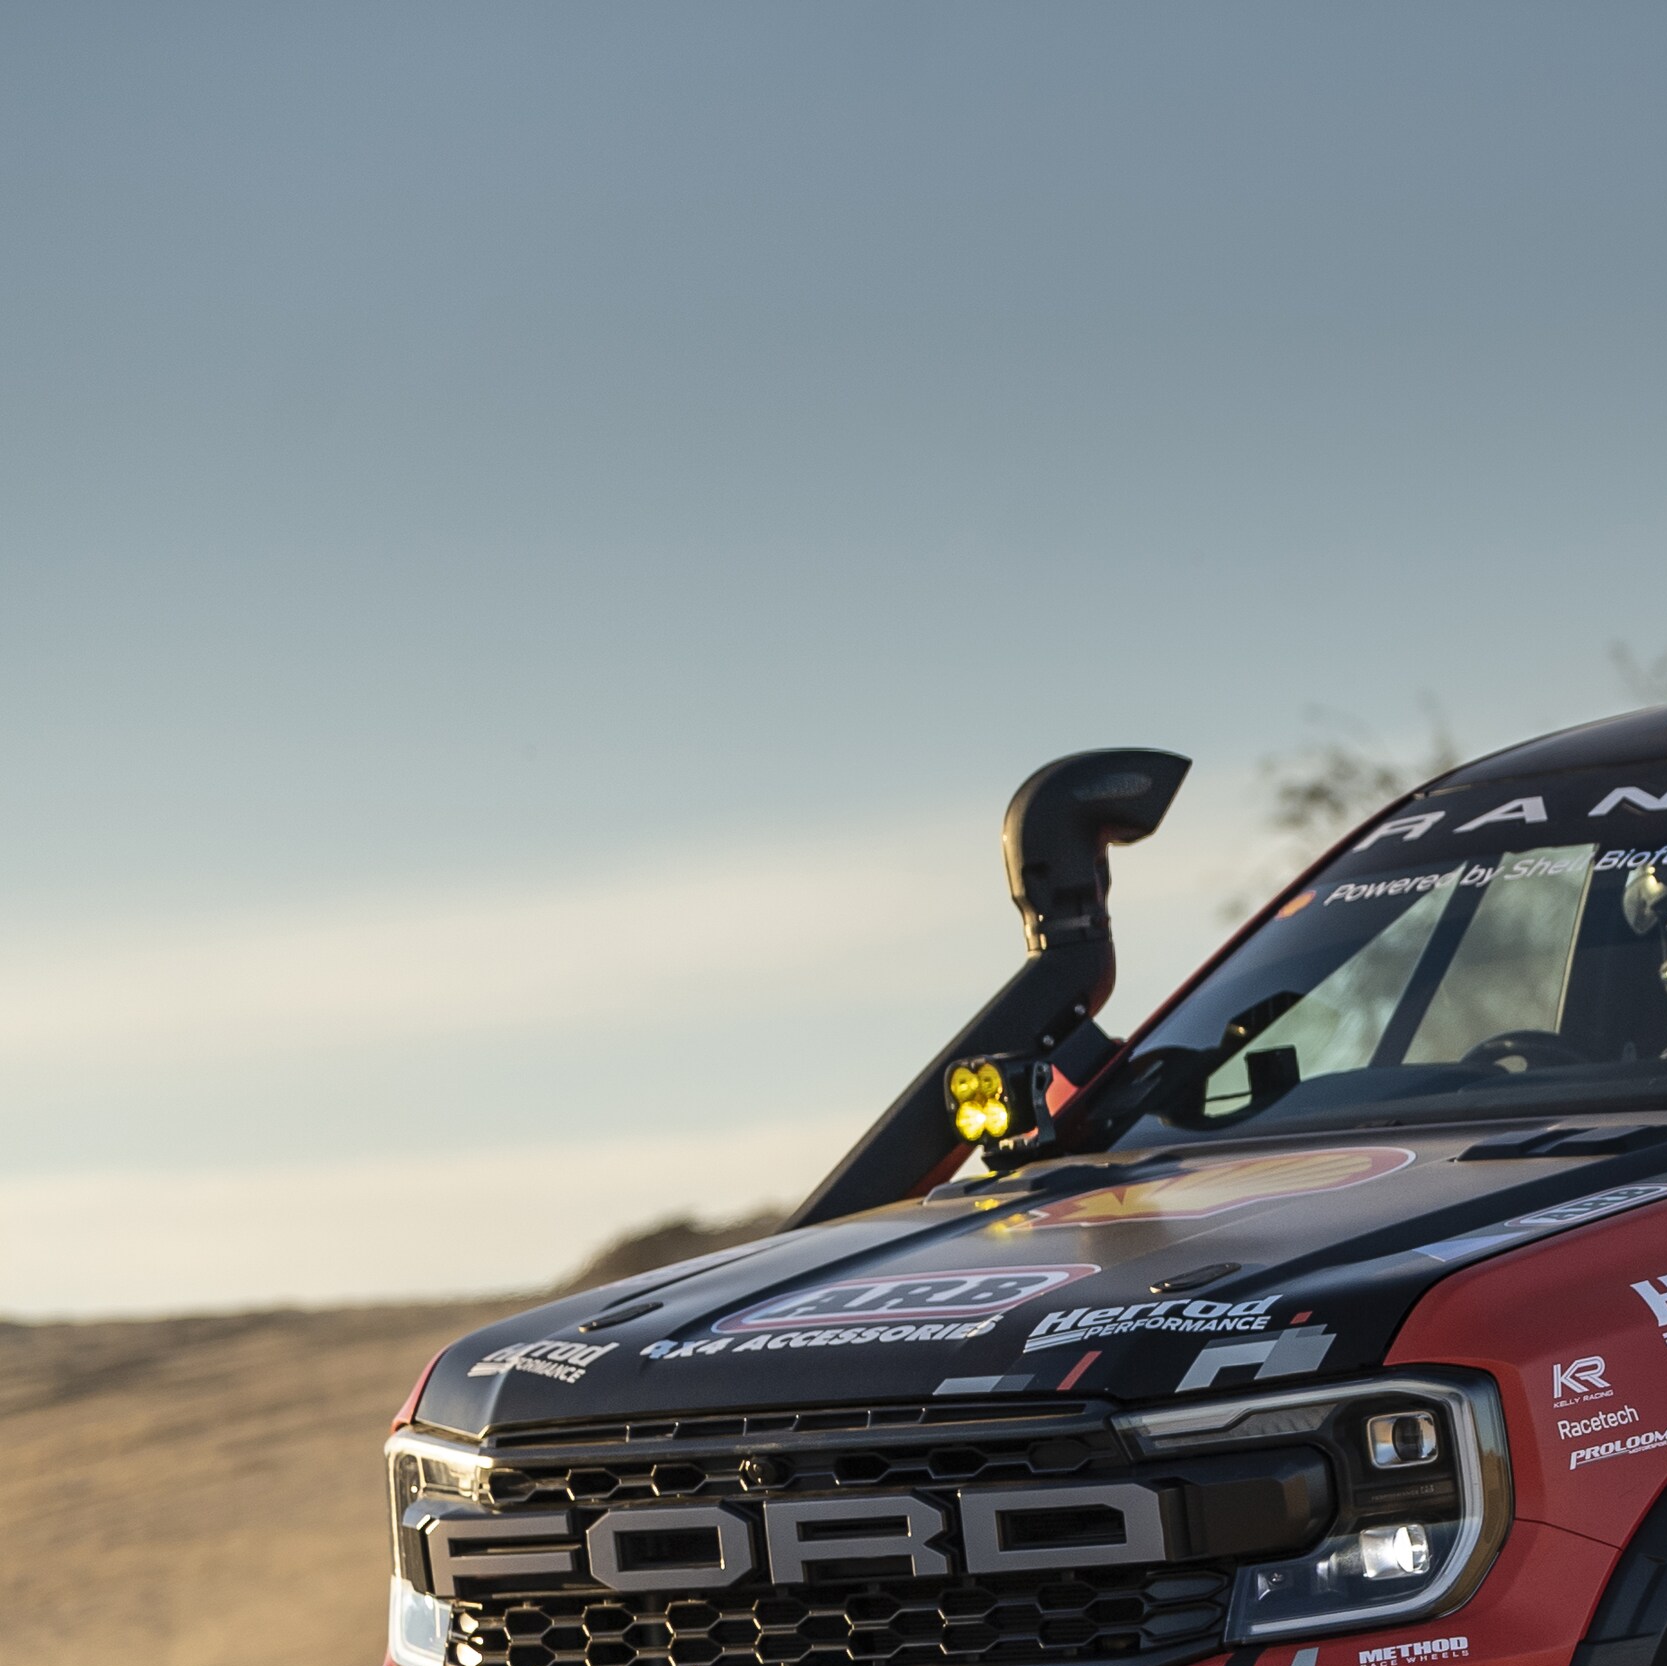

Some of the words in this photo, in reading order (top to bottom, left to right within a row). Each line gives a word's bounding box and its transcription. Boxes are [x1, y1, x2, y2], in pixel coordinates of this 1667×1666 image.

[1324, 864, 1460, 906] Powered
[1459, 862, 1503, 894] by
[754, 1276, 1053, 1322] ARB
[1028, 1294, 1284, 1338] Herrod
[732, 1315, 1004, 1352] ACCESSORIES
[1083, 1315, 1271, 1340] PERFORMANCE
[1553, 1355, 1612, 1399] KR
[1553, 1397, 1581, 1409] KELLY
[1583, 1389, 1614, 1402] RACING
[1557, 1405, 1640, 1440] Racetech
[421, 1482, 1168, 1599] FORD
[1358, 1636, 1469, 1664] METHOD
[1406, 1650, 1470, 1664] WHEELS
